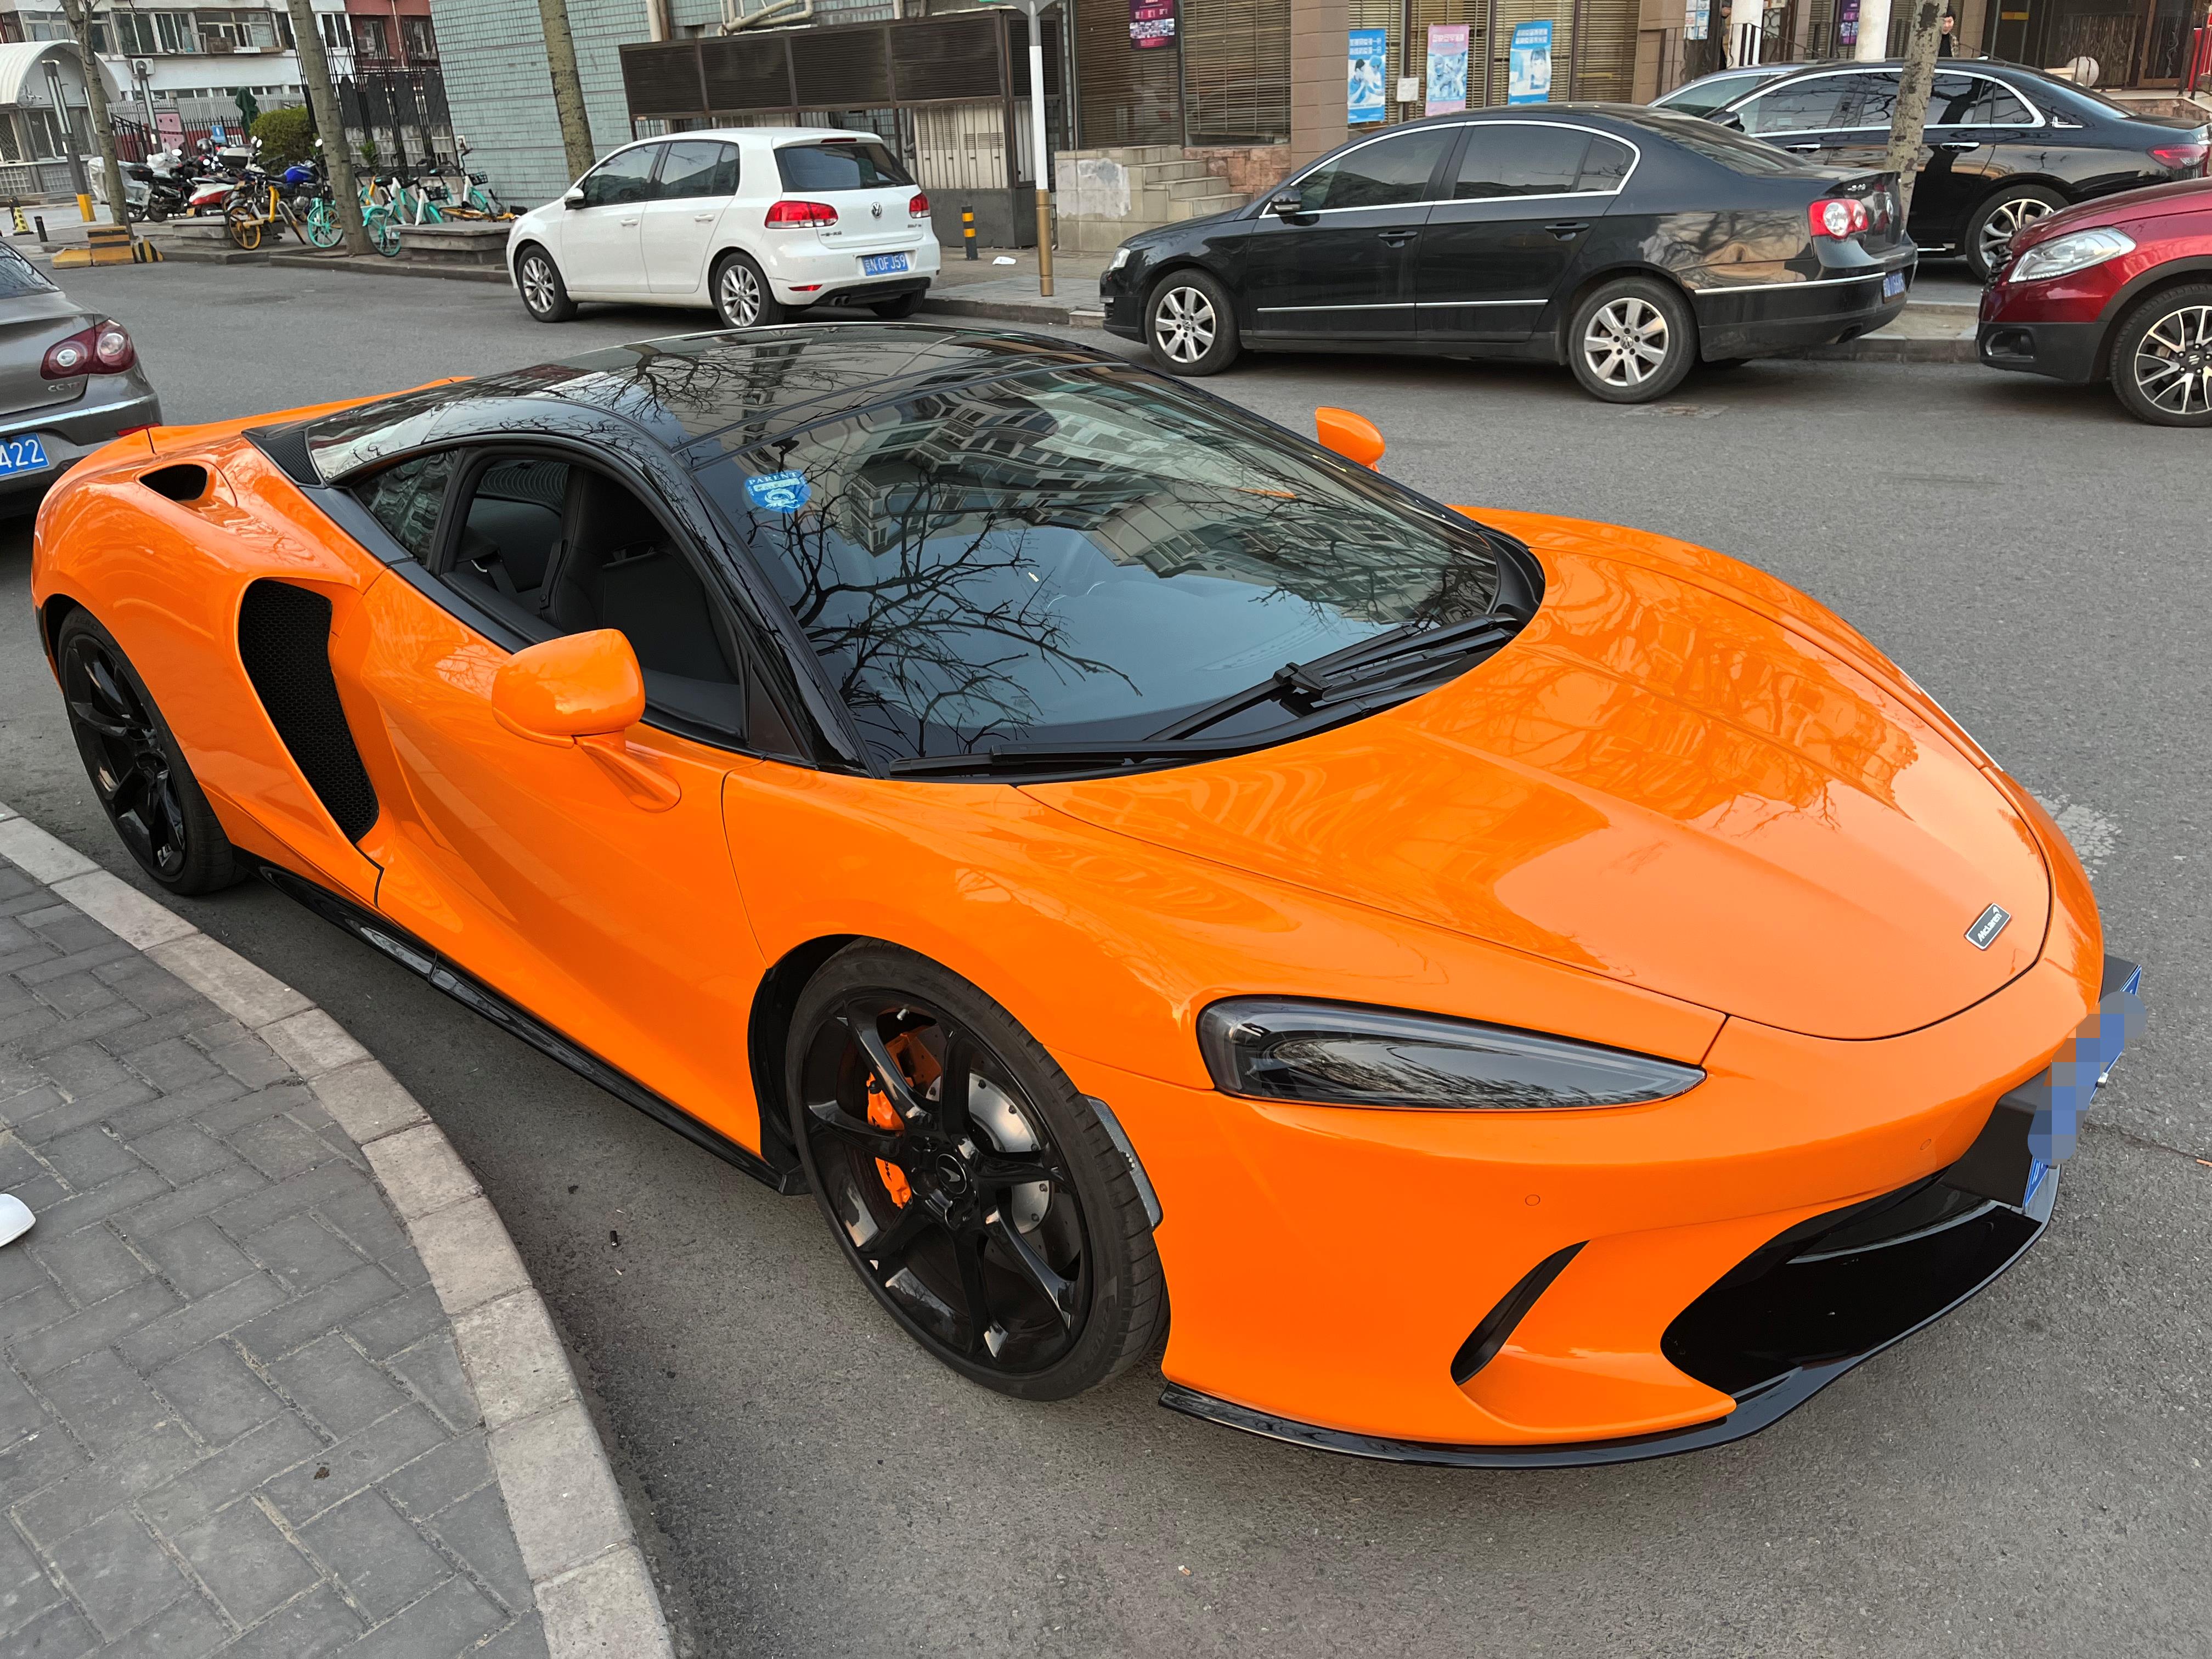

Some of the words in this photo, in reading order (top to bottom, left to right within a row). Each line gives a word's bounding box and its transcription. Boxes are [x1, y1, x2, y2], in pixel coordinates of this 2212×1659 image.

[0, 439, 44, 468] 422
[748, 472, 797, 485] PARENT
[1977, 912, 2002, 943] McLaren
